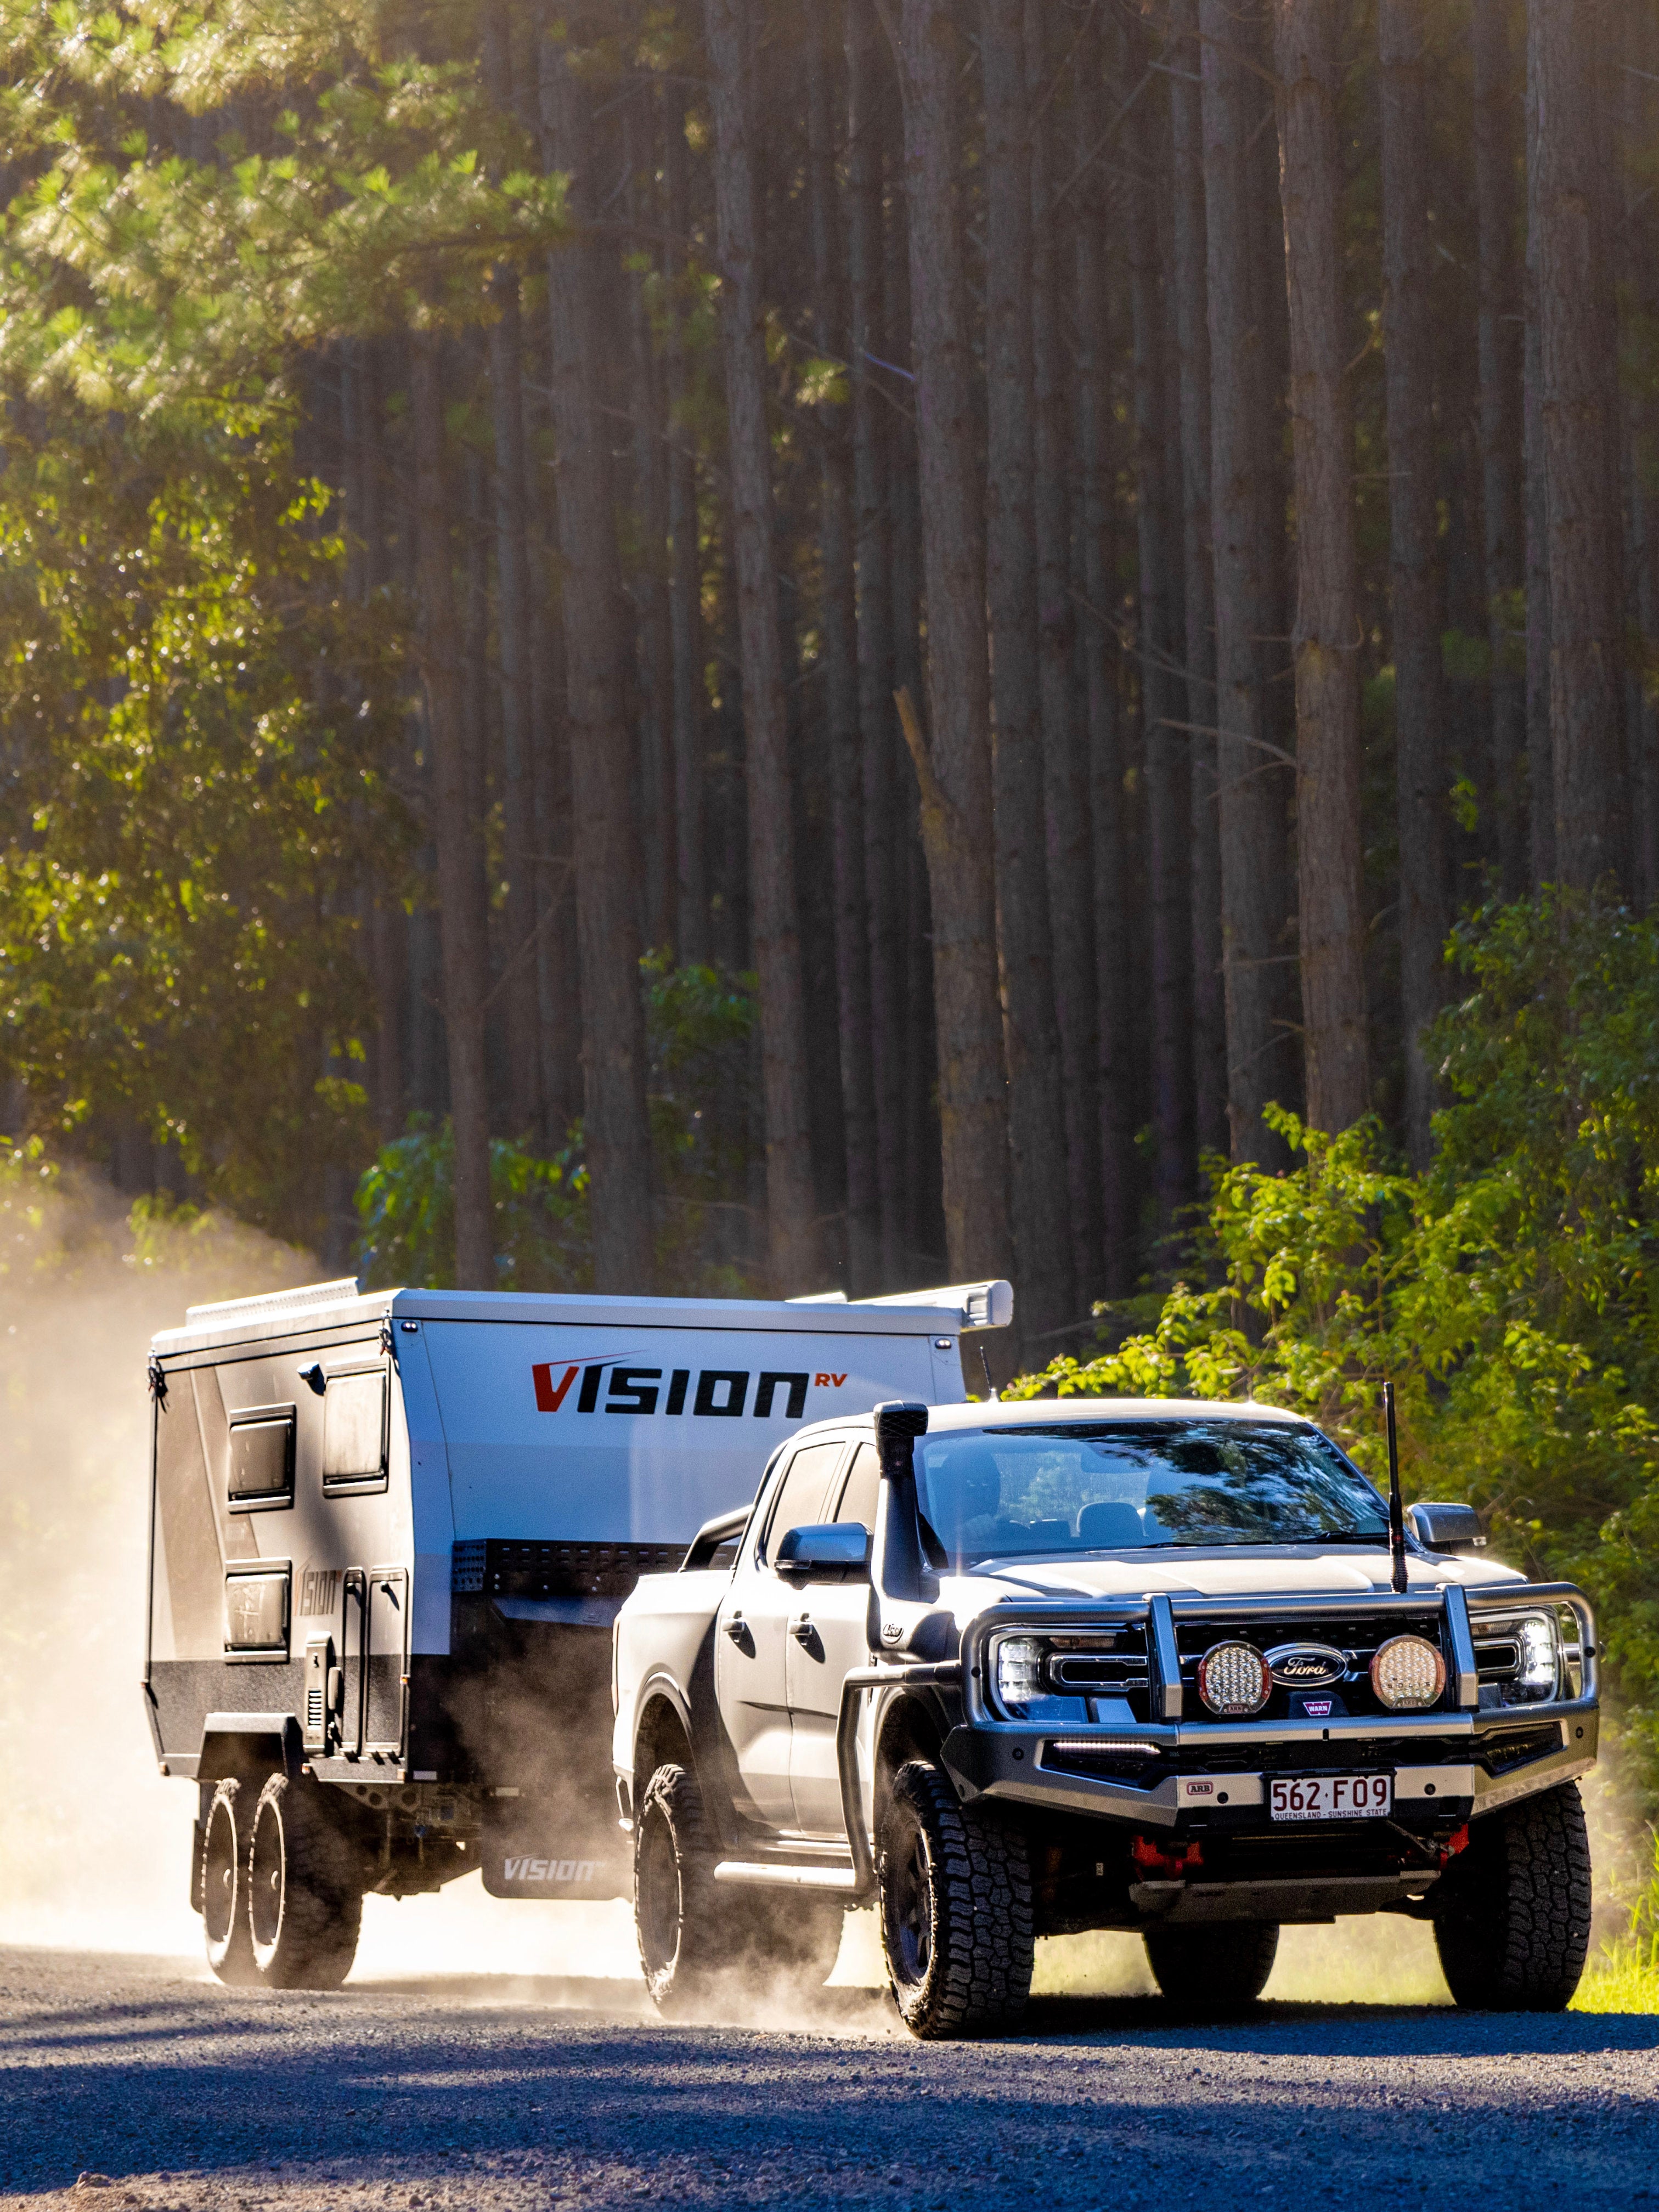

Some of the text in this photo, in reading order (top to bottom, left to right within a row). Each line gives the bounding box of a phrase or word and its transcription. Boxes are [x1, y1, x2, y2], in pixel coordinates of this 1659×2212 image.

[814, 1373, 848, 1387] RV
[1284, 1657, 1327, 1675] Ford
[1189, 1784, 1211, 1792] ARB
[1274, 1812, 1321, 1820] QUEENSLAND
